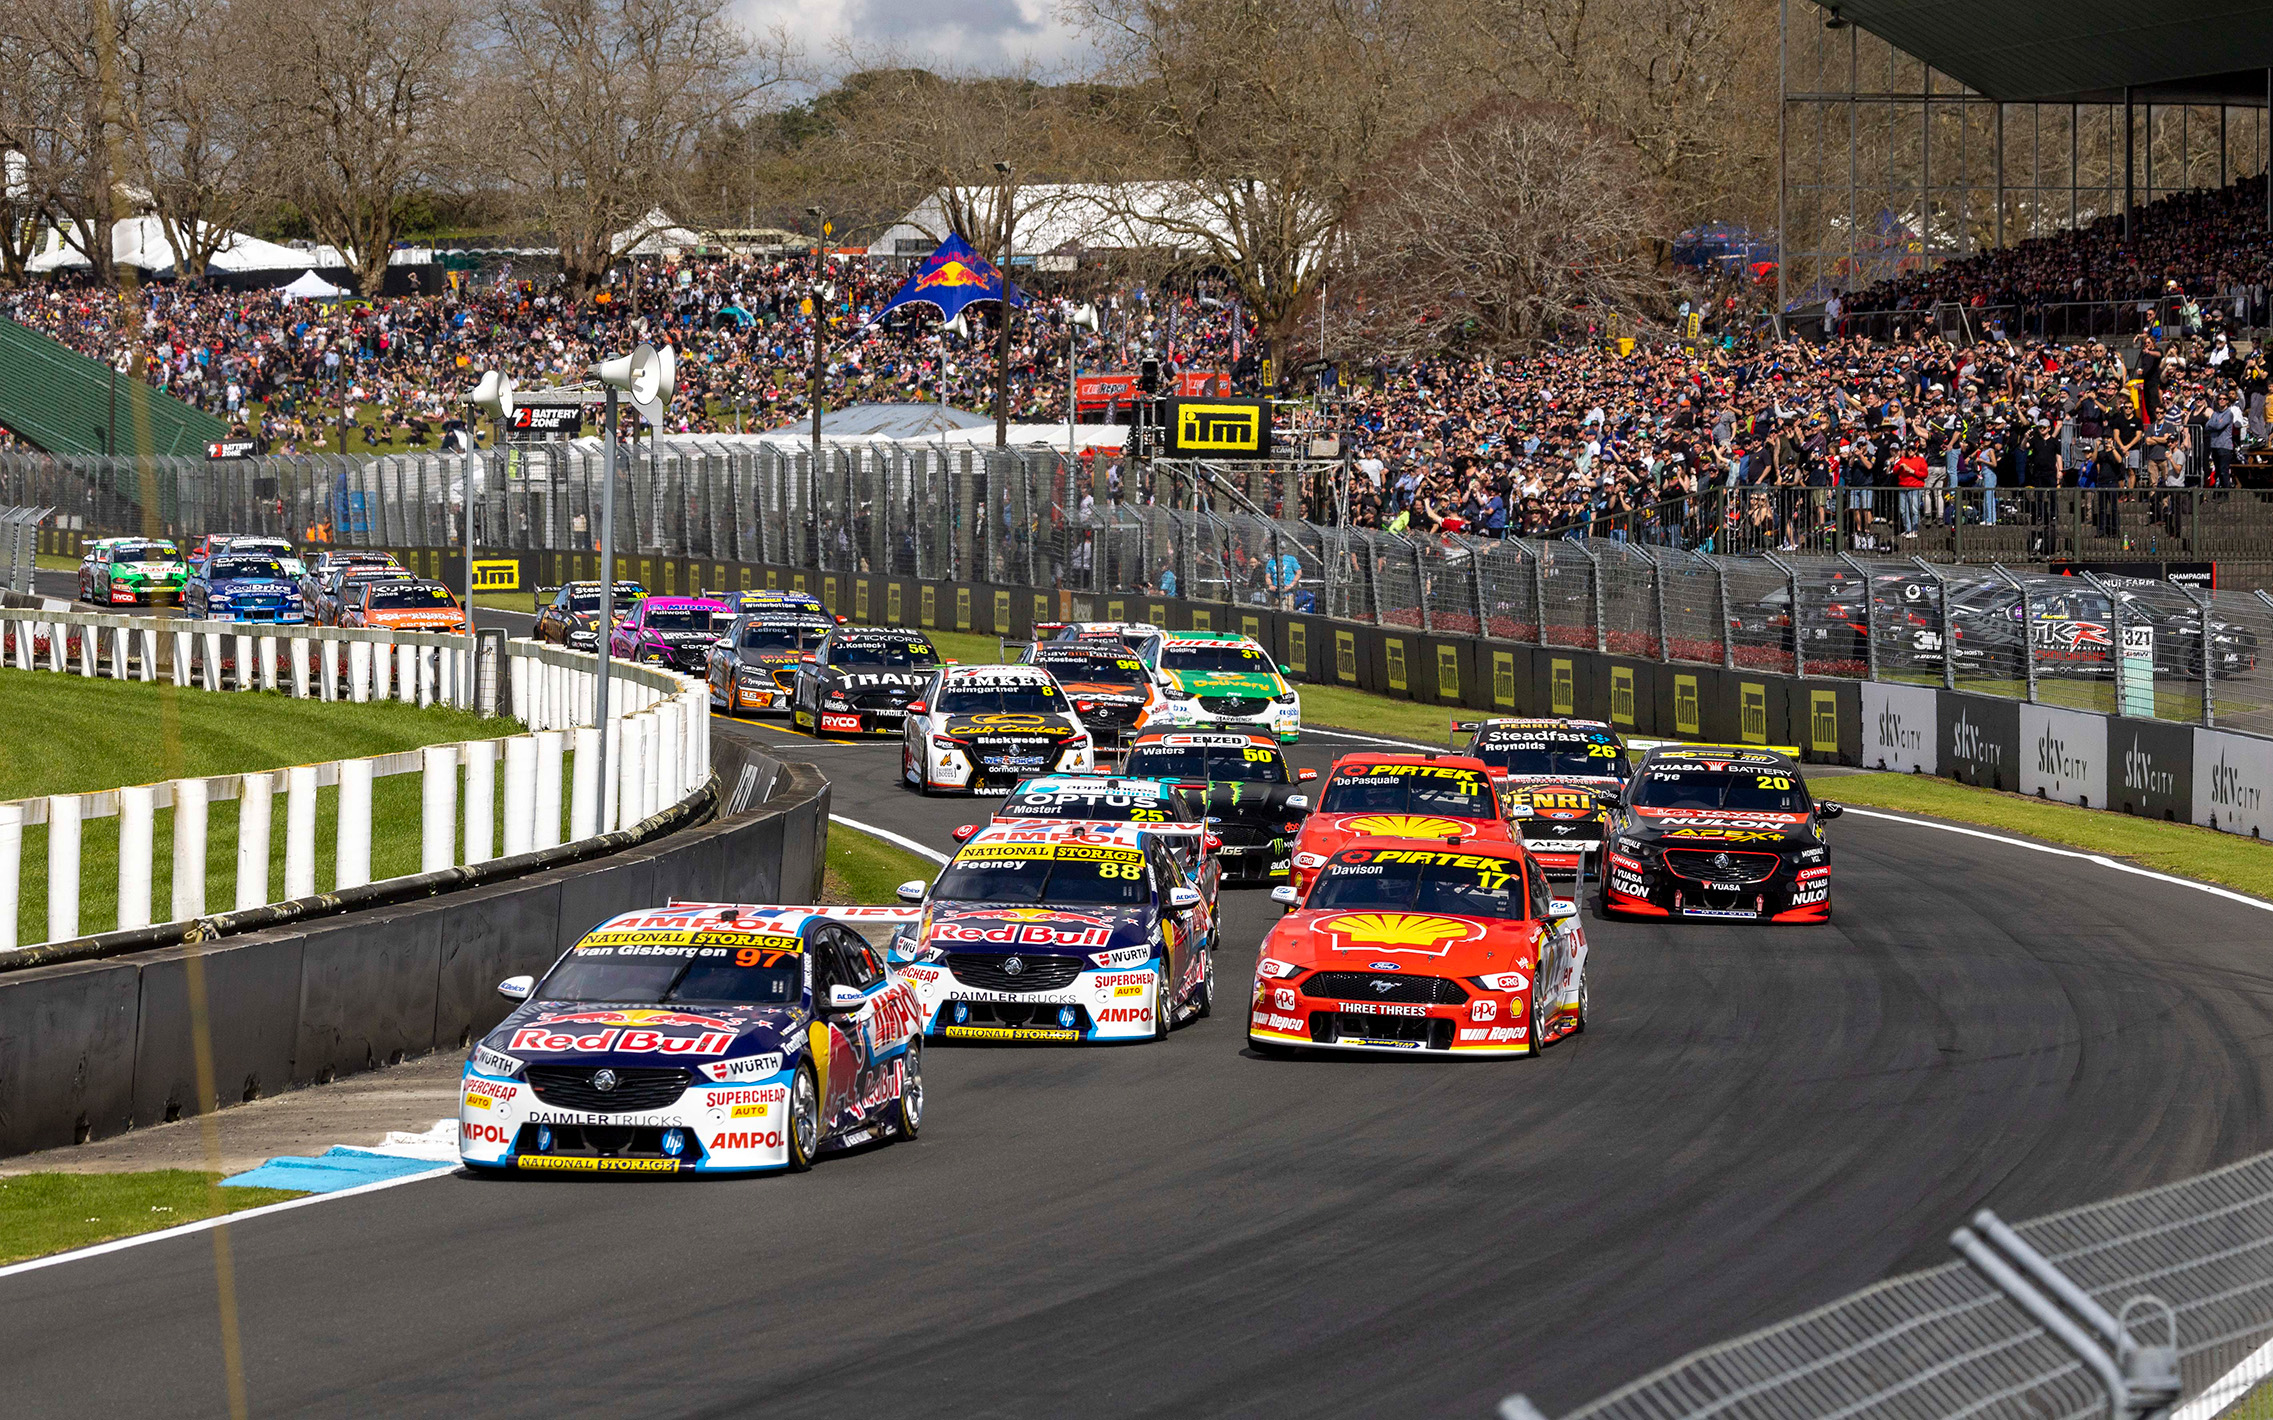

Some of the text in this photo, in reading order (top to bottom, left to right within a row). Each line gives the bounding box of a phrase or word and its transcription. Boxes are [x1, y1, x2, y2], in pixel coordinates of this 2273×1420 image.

[531, 408, 579, 419] BATTERY
[530, 418, 560, 428] ZONE
[222, 442, 254, 451] BATTERY
[269, 562, 280, 570] 3
[2168, 572, 2211, 580] CHAMPAGNE
[112, 593, 134, 601] RYCO
[431, 590, 449, 599] 96
[1913, 631, 1943, 650] 3M
[2124, 629, 2150, 646] 321
[836, 642, 886, 650] J.Kostecki
[908, 643, 929, 655] 56
[1169, 646, 1197, 654] Golding
[1241, 649, 1261, 659] 31
[1116, 660, 1141, 671] 99
[747, 678, 776, 688] Tyrepower
[947, 676, 1052, 687] TIMKEN
[1193, 679, 1270, 691] Delivery
[1041, 686, 1055, 697] 8
[822, 715, 858, 728] RYCO
[949, 724, 1071, 735] Cub Cadet
[977, 736, 1050, 744] Blackwoods
[1191, 736, 1243, 745] ENZED
[1488, 730, 1589, 743] Steadfast
[1142, 747, 1186, 756] Waters
[1485, 741, 1546, 752] Reynolds
[1587, 743, 1617, 758] 26
[1242, 748, 1273, 763] 50
[1368, 765, 1480, 782] PIRTEK
[1648, 764, 1794, 777] YUASA BATTERY
[1653, 772, 1681, 782] Pye
[1351, 775, 1400, 787] Pasquale
[1756, 776, 1790, 791] 20
[1456, 780, 1479, 797] 11
[1023, 792, 1159, 809] OPTUS
[1501, 793, 1600, 810] PENRI
[1013, 804, 1063, 814] Mostert
[1130, 808, 1165, 823] 25
[1696, 809, 1796, 820] TOYOTA
[1659, 817, 1786, 830] NULON
[976, 831, 1137, 846] AMPOL
[962, 846, 1139, 862] NATIONAL STORAGE
[956, 860, 1027, 871] Feeney
[1372, 850, 1510, 873] PIRTEK
[1098, 862, 1141, 881] 88
[1331, 864, 1384, 876] Davison
[1616, 869, 1643, 884] YUASA
[1477, 870, 1512, 889] 17
[1807, 879, 1828, 889] YUASA
[1610, 876, 1650, 898] NULON
[1711, 883, 1741, 892] YUASA
[1792, 887, 1828, 905] NULON
[602, 915, 796, 935] AMPOL
[582, 931, 795, 949] NATIONAL STORAGE
[931, 923, 1112, 946] Red Bull
[577, 945, 728, 958] van Gisbergen
[735, 948, 787, 969] 97
[1263, 962, 1280, 975] CRC
[1094, 973, 1155, 988] SUPERCHEAP
[1498, 975, 1519, 988] CRC
[950, 991, 1077, 1004] DAIMLER TRUCKS
[1116, 987, 1141, 995] AUTO
[1275, 990, 1295, 1009] PPG
[1097, 1008, 1154, 1022] AMPOL
[1338, 1001, 1426, 1016] THREE THREES
[1473, 1002, 1496, 1019] PPG
[1060, 1006, 1076, 1027] hp
[1267, 1012, 1305, 1031] Repco
[949, 1028, 1074, 1041] NATIONAL STORAGE
[1488, 1026, 1528, 1042] Repco
[510, 1029, 736, 1055] Red Bull
[466, 1095, 490, 1107] AUTO
[706, 1087, 786, 1107] SUPERCHEAP
[734, 1106, 765, 1116] AUTO
[529, 1111, 683, 1127] DAIMLER TRUCKS
[462, 1122, 510, 1144] MPOL
[664, 1129, 685, 1155] hp
[709, 1131, 785, 1149] AMPOL
[520, 1156, 674, 1172] NATIONAL STORAGE
